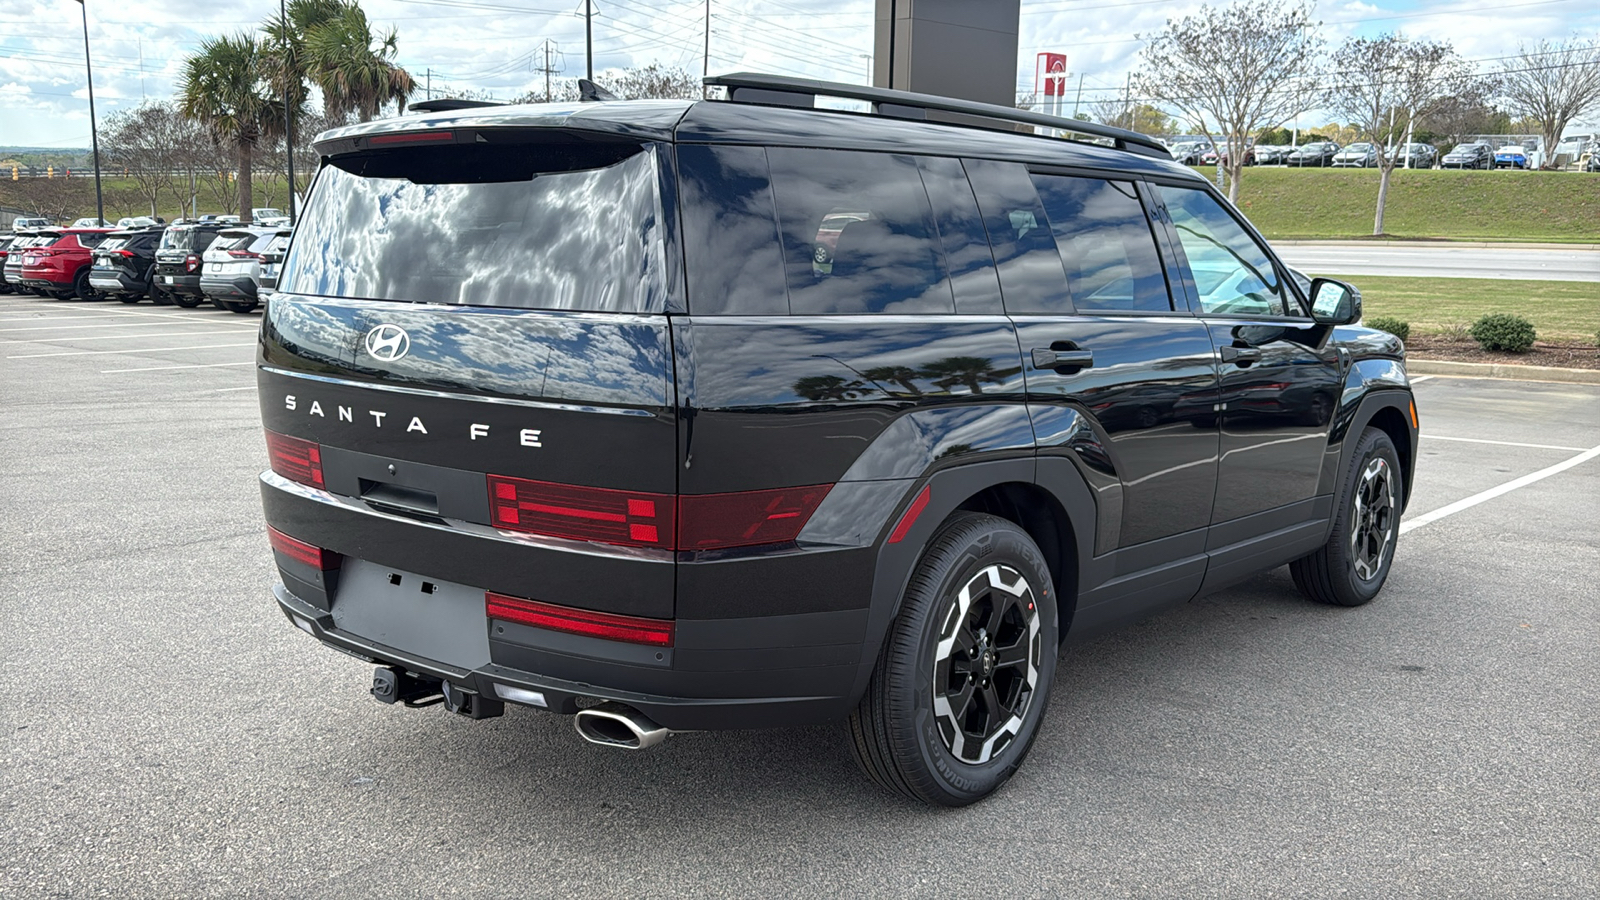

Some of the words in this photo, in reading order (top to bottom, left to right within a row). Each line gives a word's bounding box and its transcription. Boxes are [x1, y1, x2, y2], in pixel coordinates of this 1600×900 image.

[285, 395, 428, 434] SANTA
[470, 423, 542, 448] FE
[1011, 541, 1053, 599] NEXEN
